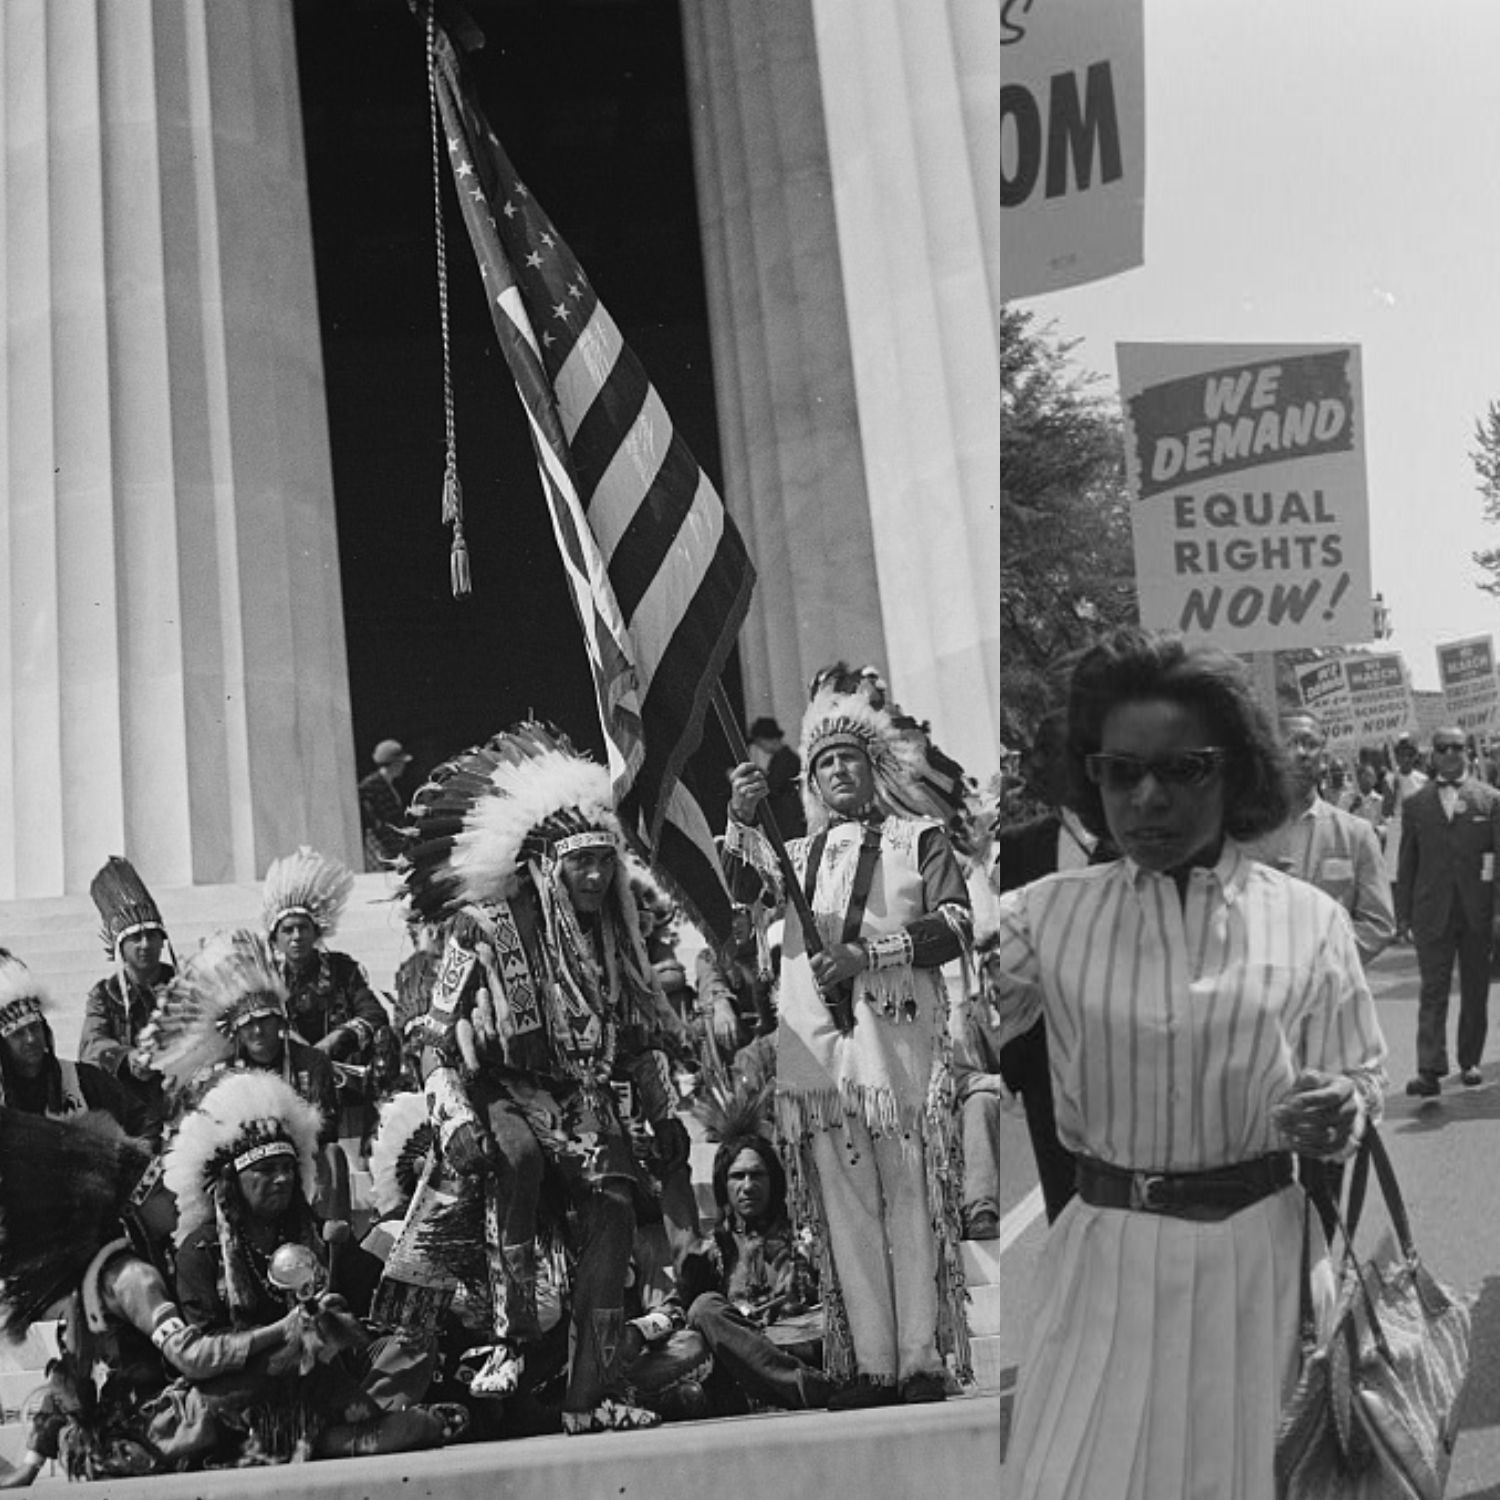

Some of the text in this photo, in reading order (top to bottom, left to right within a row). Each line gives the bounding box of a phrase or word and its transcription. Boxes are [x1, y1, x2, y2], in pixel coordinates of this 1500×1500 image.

[1204, 365, 1282, 420] WE
[1151, 399, 1348, 482] DEMAND
[1174, 490, 1335, 529] EQUAL
[1174, 533, 1343, 574] RIGHTS
[1180, 571, 1350, 633] NOW!
[1363, 713, 1409, 732] NOW!
